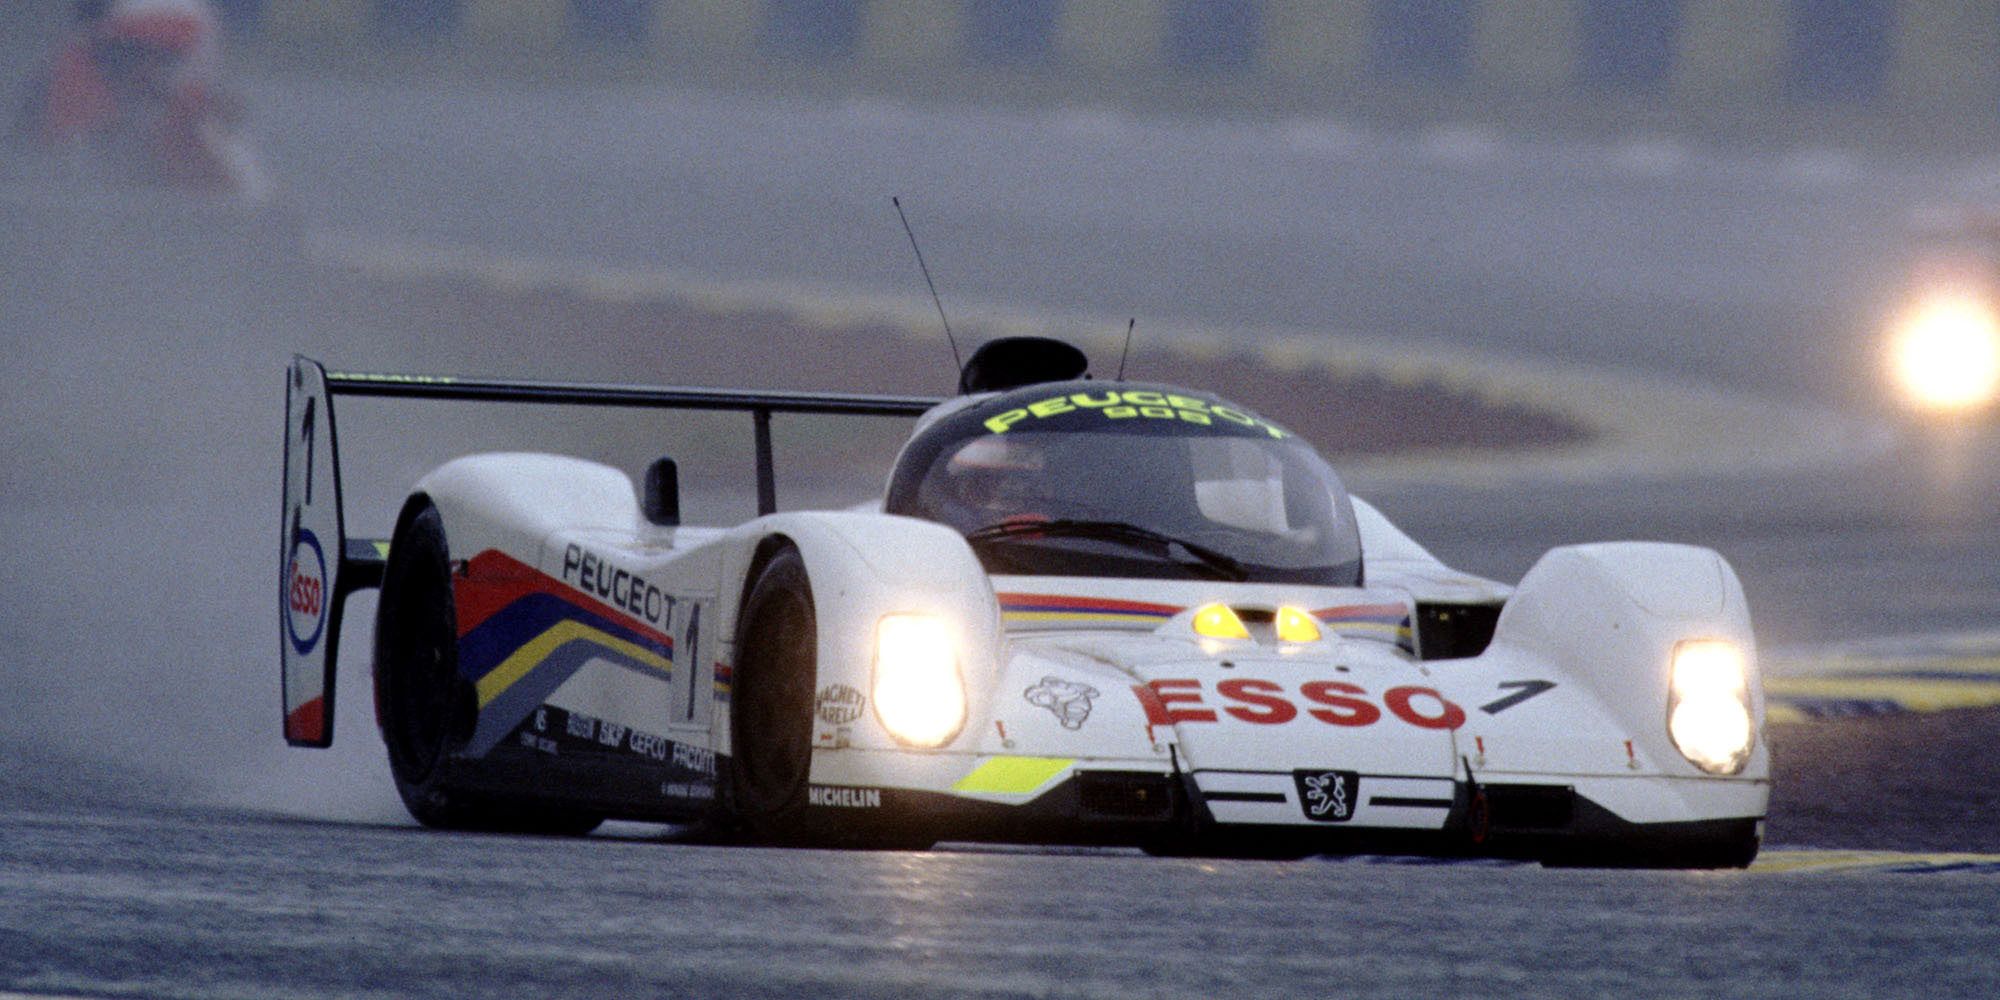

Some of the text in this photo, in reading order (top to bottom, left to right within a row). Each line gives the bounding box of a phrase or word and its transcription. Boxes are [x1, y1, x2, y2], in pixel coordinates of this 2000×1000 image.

[984, 391, 1286, 438] PEUGEOT
[1103, 406, 1212, 426] 905
[302, 396, 316, 506] 1
[563, 542, 677, 631] PEUGEOT
[685, 602, 700, 720] 1
[1131, 678, 1466, 730] ESSO
[808, 786, 881, 808] MICHELIN
